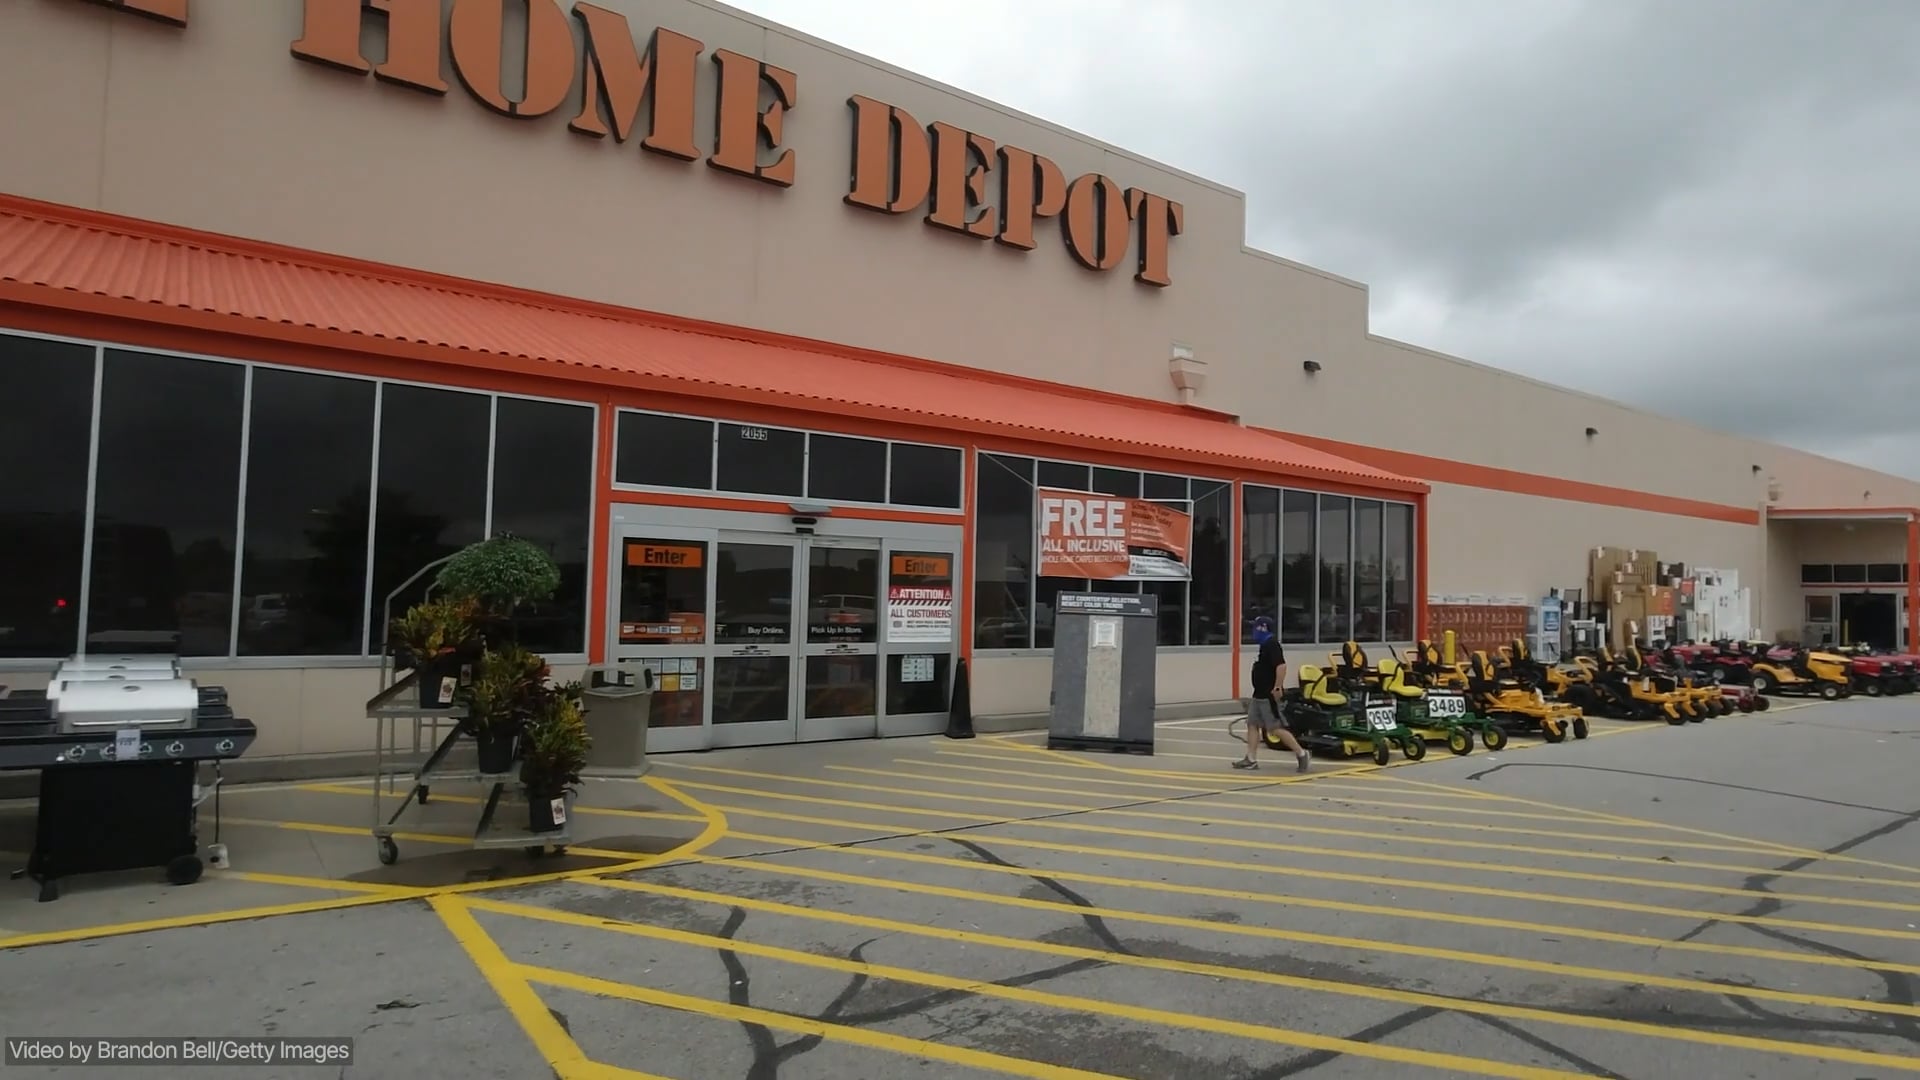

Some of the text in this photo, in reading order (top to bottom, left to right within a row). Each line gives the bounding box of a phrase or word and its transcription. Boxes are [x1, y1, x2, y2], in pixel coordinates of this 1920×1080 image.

[290, 0, 1183, 288] HOME DEPOT
[741, 426, 768, 440] 2055
[1041, 498, 1126, 537] FREE
[1043, 538, 1064, 553] ALL
[644, 547, 687, 565] Enter
[905, 559, 938, 574] Enter
[900, 588, 944, 600] ATTENTION
[890, 608, 952, 619] ALL CUSTOMERS
[747, 626, 761, 635] Buy
[1431, 698, 1465, 713] 3489
